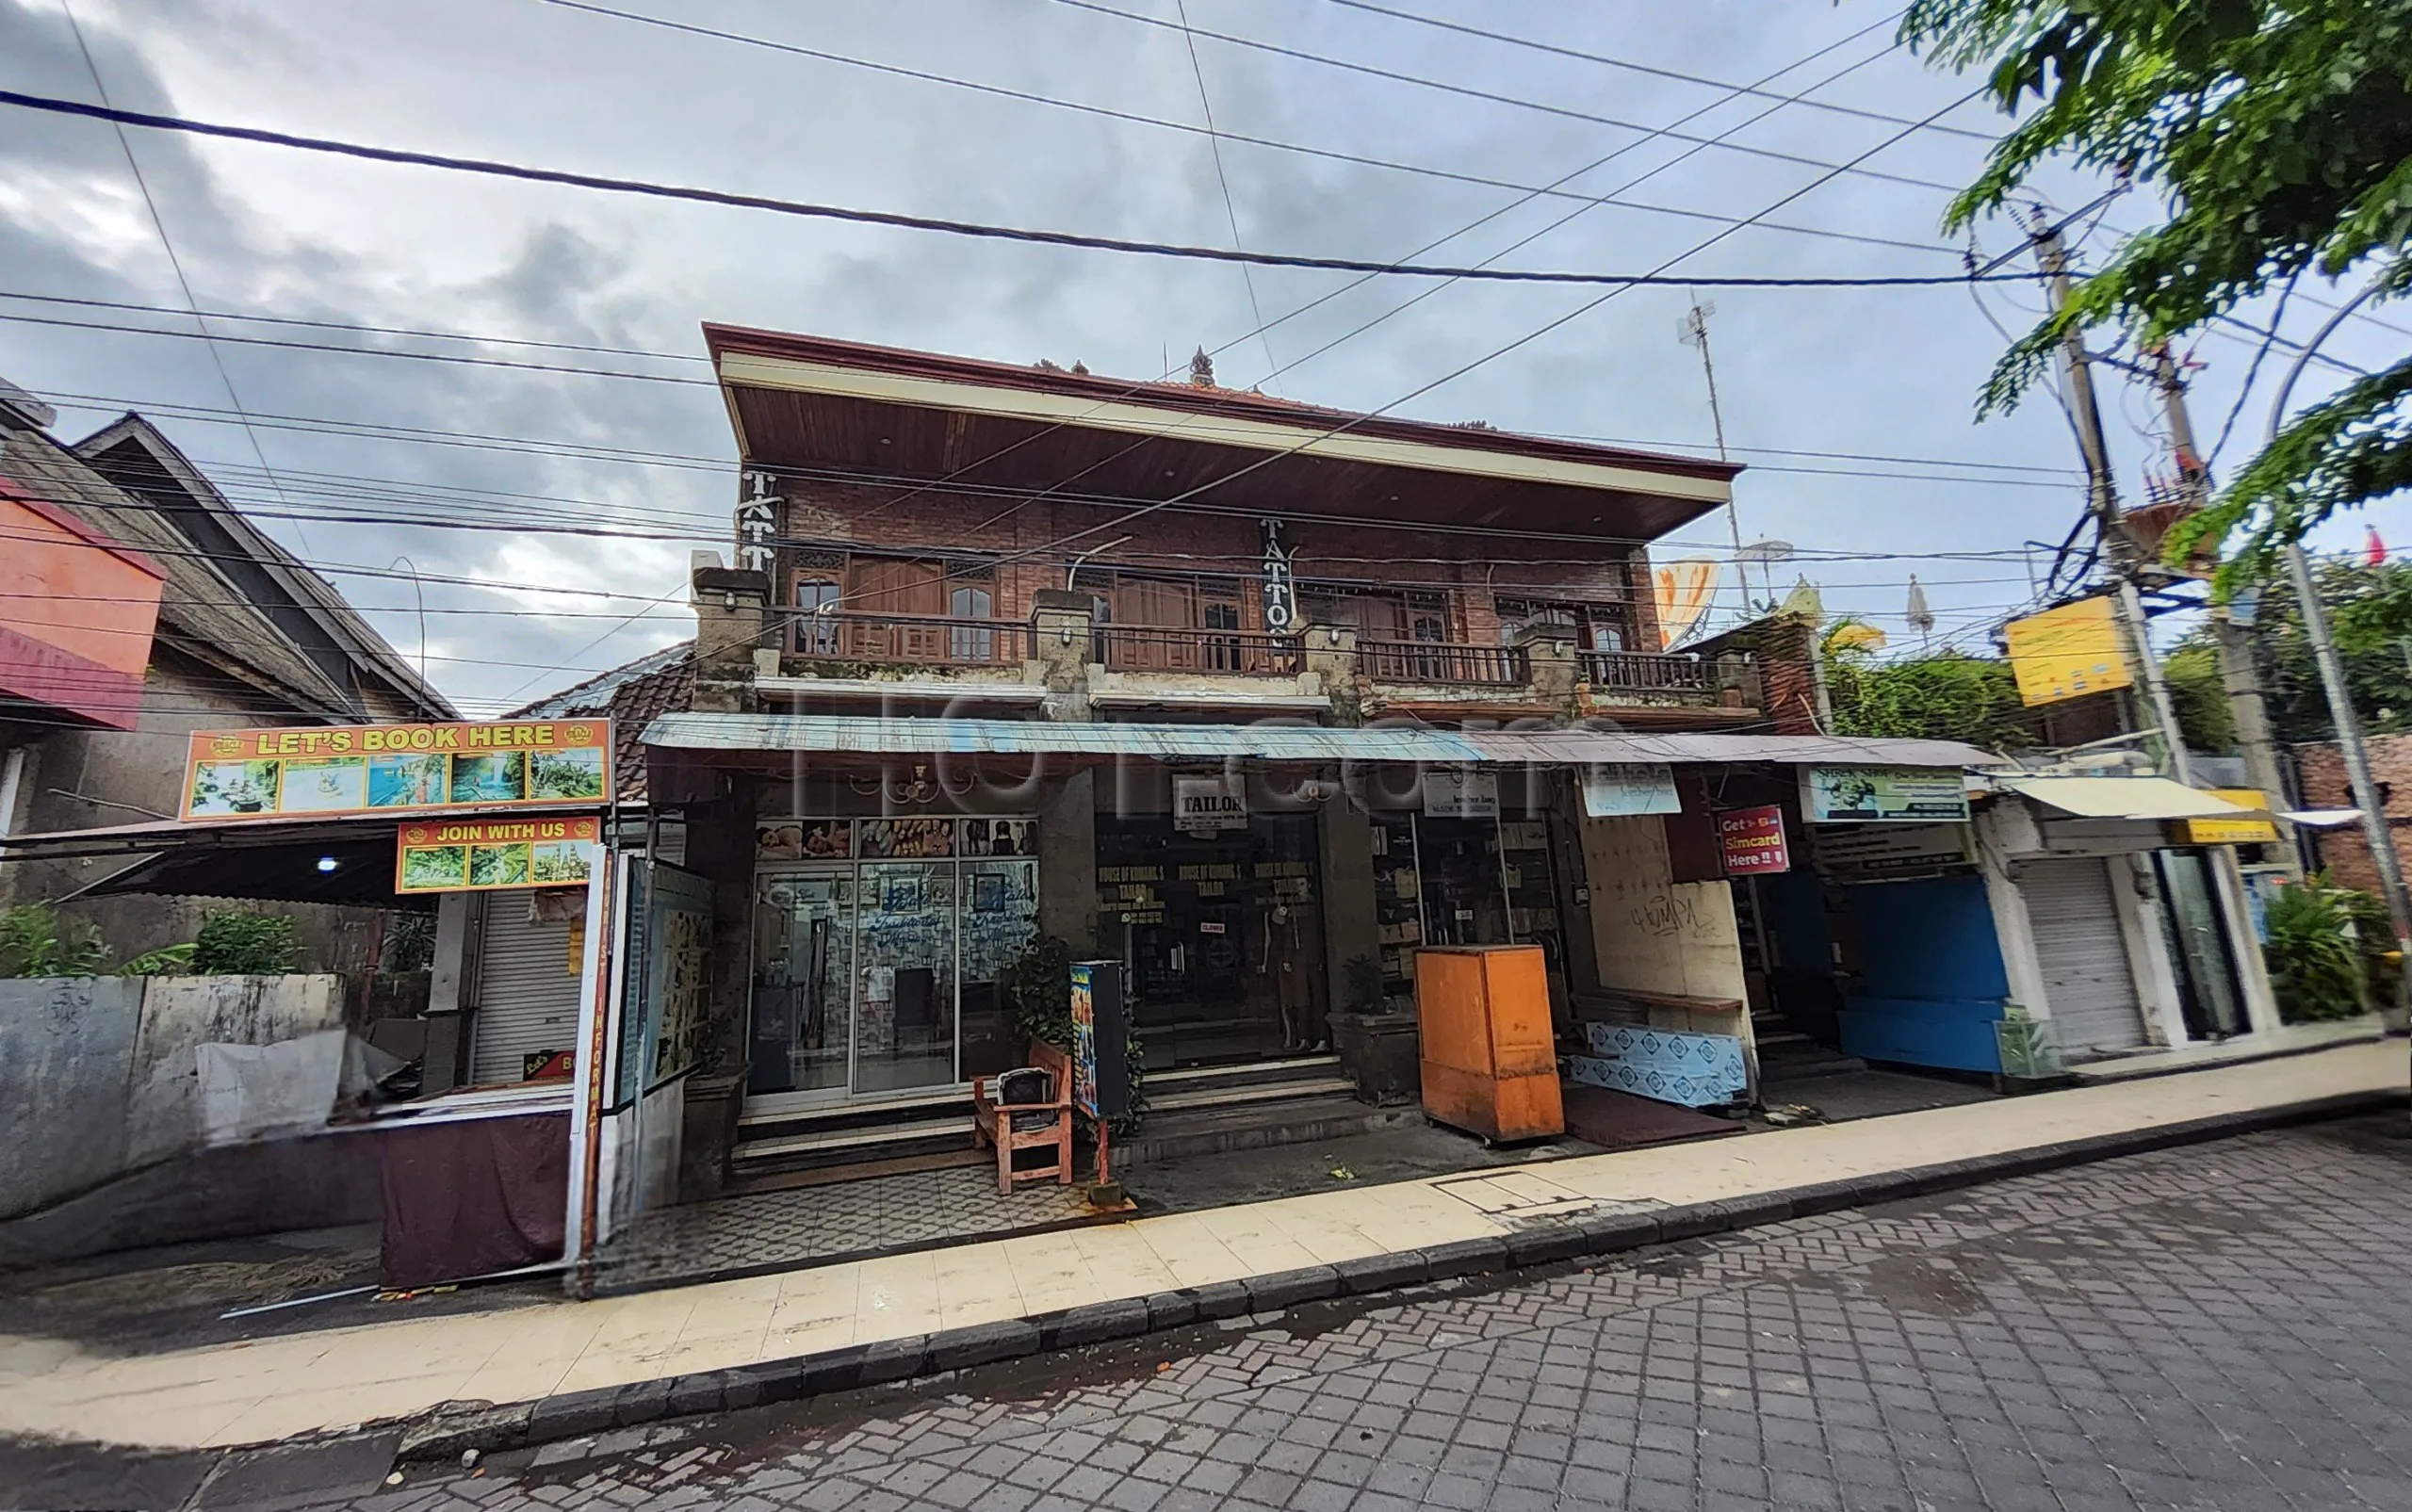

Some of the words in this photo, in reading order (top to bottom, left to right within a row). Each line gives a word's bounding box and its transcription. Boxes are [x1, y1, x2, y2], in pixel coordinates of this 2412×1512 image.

[256, 731, 354, 756] LET'S
[362, 725, 460, 752] BOOK
[469, 724, 555, 747] HERE
[1181, 796, 1242, 813] TAILOR
[1453, 794, 1479, 804] leaher
[436, 825, 482, 841] JOIN
[487, 823, 535, 839] WITH
[541, 822, 565, 837] US
[1722, 819, 1746, 832] Get
[1725, 832, 1781, 850] Simcard
[1728, 854, 1760, 867] Here
